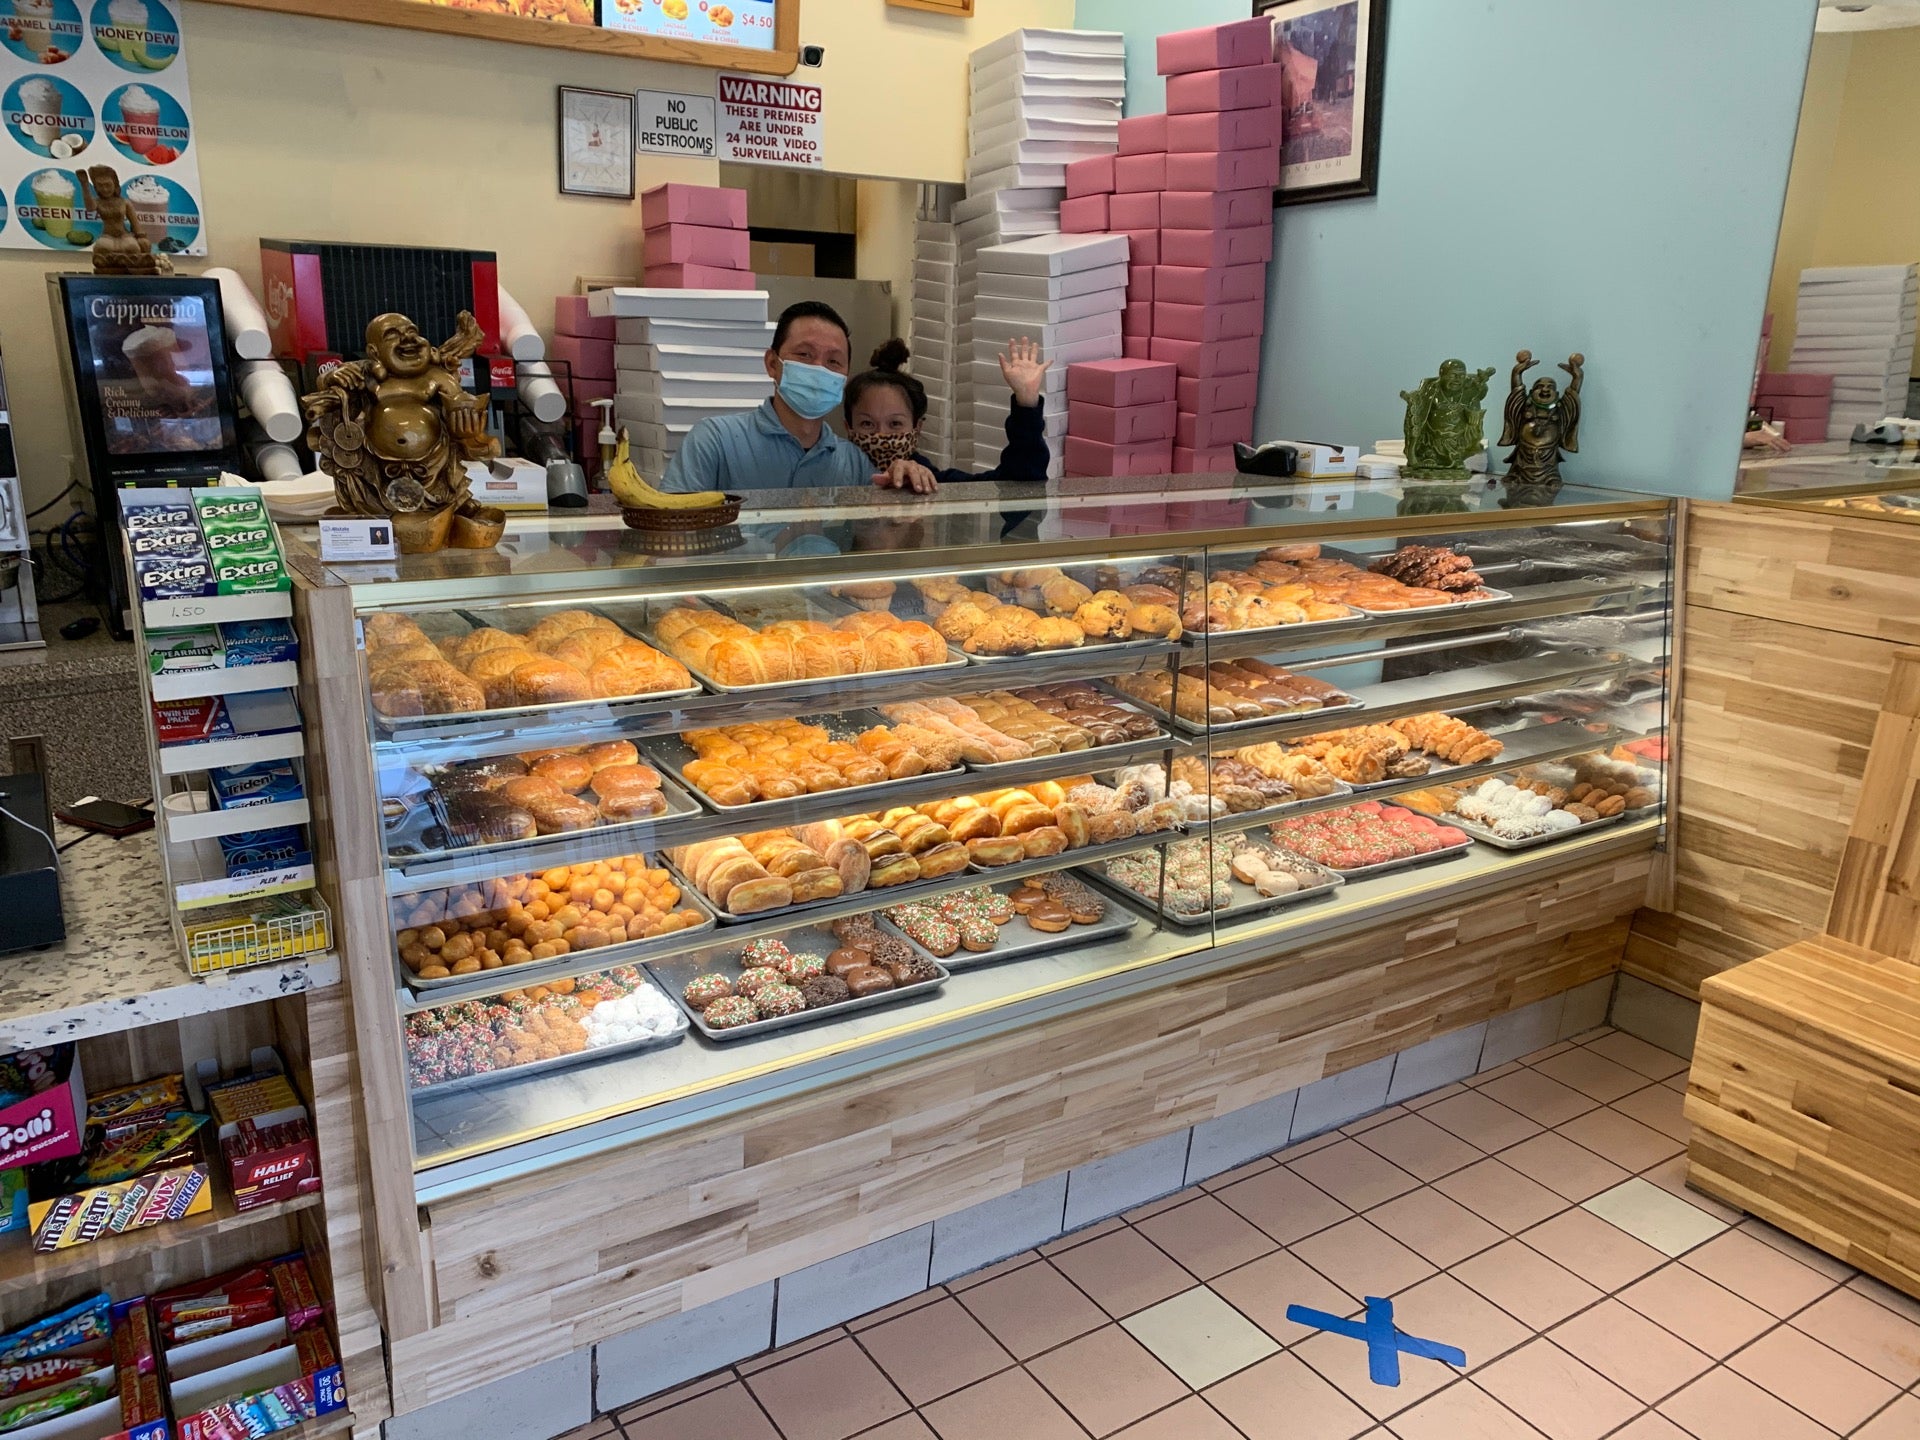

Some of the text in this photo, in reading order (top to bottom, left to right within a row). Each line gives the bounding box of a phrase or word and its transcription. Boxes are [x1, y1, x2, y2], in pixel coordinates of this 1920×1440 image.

[0, 17, 83, 34] ARAMEL LATTE
[742, 13, 773, 29] $4.50
[95, 26, 176, 46] HONEYDEW
[721, 79, 820, 110] WARNING
[667, 99, 686, 114] NO
[726, 105, 817, 125] THESE PREMISES
[11, 112, 86, 129] COCONUT
[656, 115, 698, 132] PUBLIC
[739, 120, 804, 137] ARE UNDER
[104, 123, 188, 139] WATERMELON
[641, 131, 713, 151] RESTROOMS
[726, 133, 817, 151] 24 HOUR VIDEO
[732, 146, 812, 163] SURVEILLANCE
[18, 206, 71, 220] GREEN
[168, 215, 200, 225] CREAM
[90, 297, 197, 325] Cappuccino
[105, 397, 141, 409] Creamy
[201, 501, 258, 519] Extra
[128, 511, 188, 529] Extra
[136, 532, 197, 552] Extra
[209, 529, 268, 549] Extra
[144, 564, 206, 587] Extra
[219, 560, 279, 581] Extra
[172, 605, 206, 618] 1.50
[226, 634, 289, 647] Winterfresh
[157, 708, 200, 718] TWIN BOX
[167, 715, 191, 724] PACK
[227, 774, 275, 796] Trident
[229, 795, 273, 809] ident
[253, 1157, 300, 1179] HALLS
[263, 1171, 294, 1186] RELIEF
[167, 1171, 204, 1220] SNICKERS
